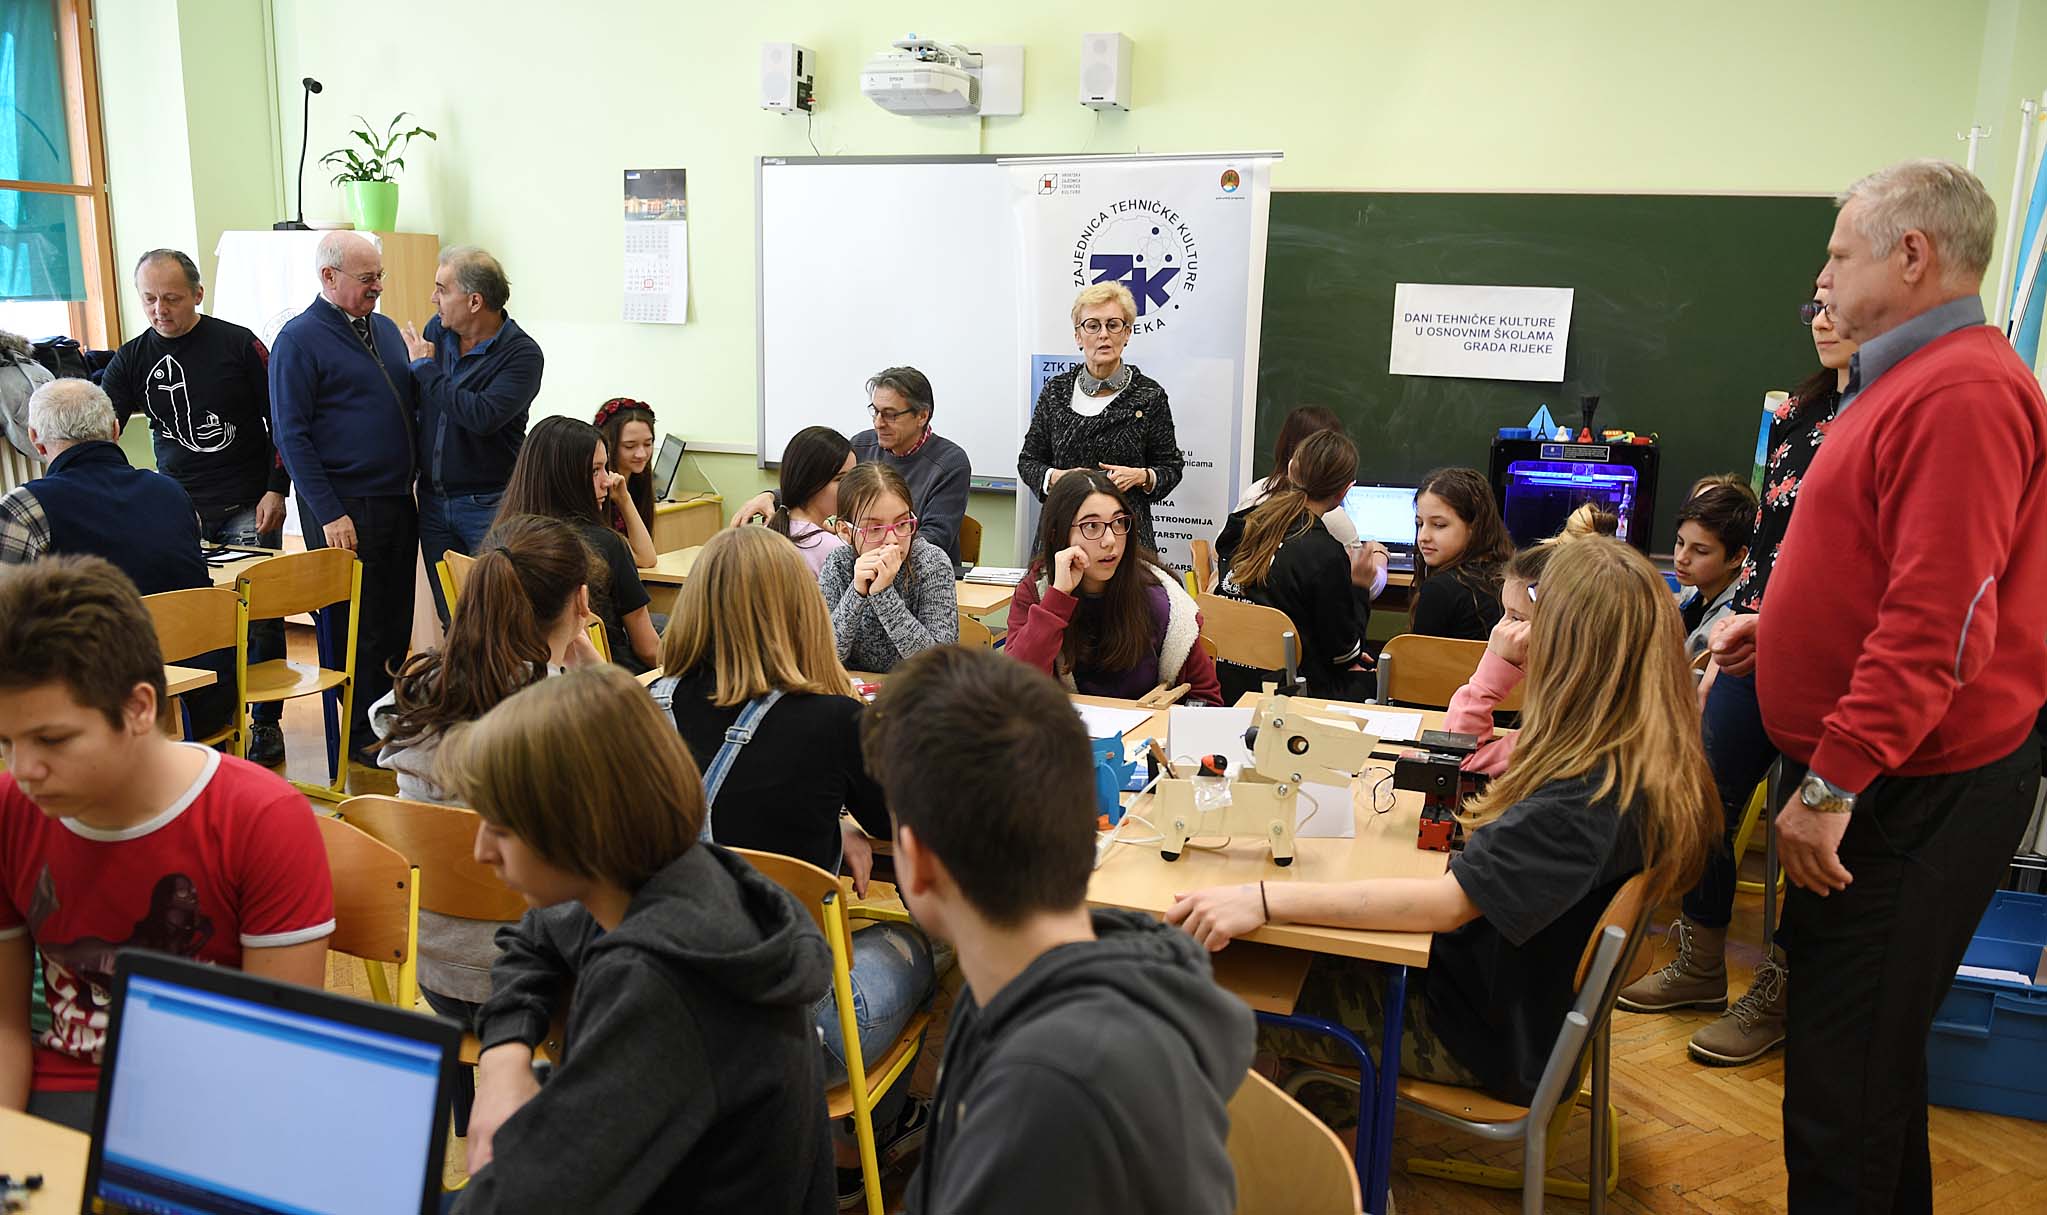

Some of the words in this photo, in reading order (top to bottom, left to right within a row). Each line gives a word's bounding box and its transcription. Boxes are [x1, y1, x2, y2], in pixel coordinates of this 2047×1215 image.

[1073, 211, 1109, 287] ZAJEDNICA
[1110, 199, 1180, 225] TEHNIČKE
[1176, 223, 1198, 292] KULTURE
[1133, 318, 1166, 335] EKA
[1404, 312, 1432, 323] DANI
[1436, 313, 1496, 326] TEHNIČKE
[1499, 316, 1556, 328] KULTURE
[1415, 326, 1423, 336] U
[1426, 326, 1490, 338] OSNOVNIM
[1494, 327, 1554, 341] ŠKOLAMA
[1463, 341, 1506, 352] GRADA
[1509, 343, 1553, 354] RIJEKE
[1043, 361, 1066, 372] ZTK
[1184, 459, 1213, 468] nicama
[1153, 531, 1193, 540] TARSTVO
